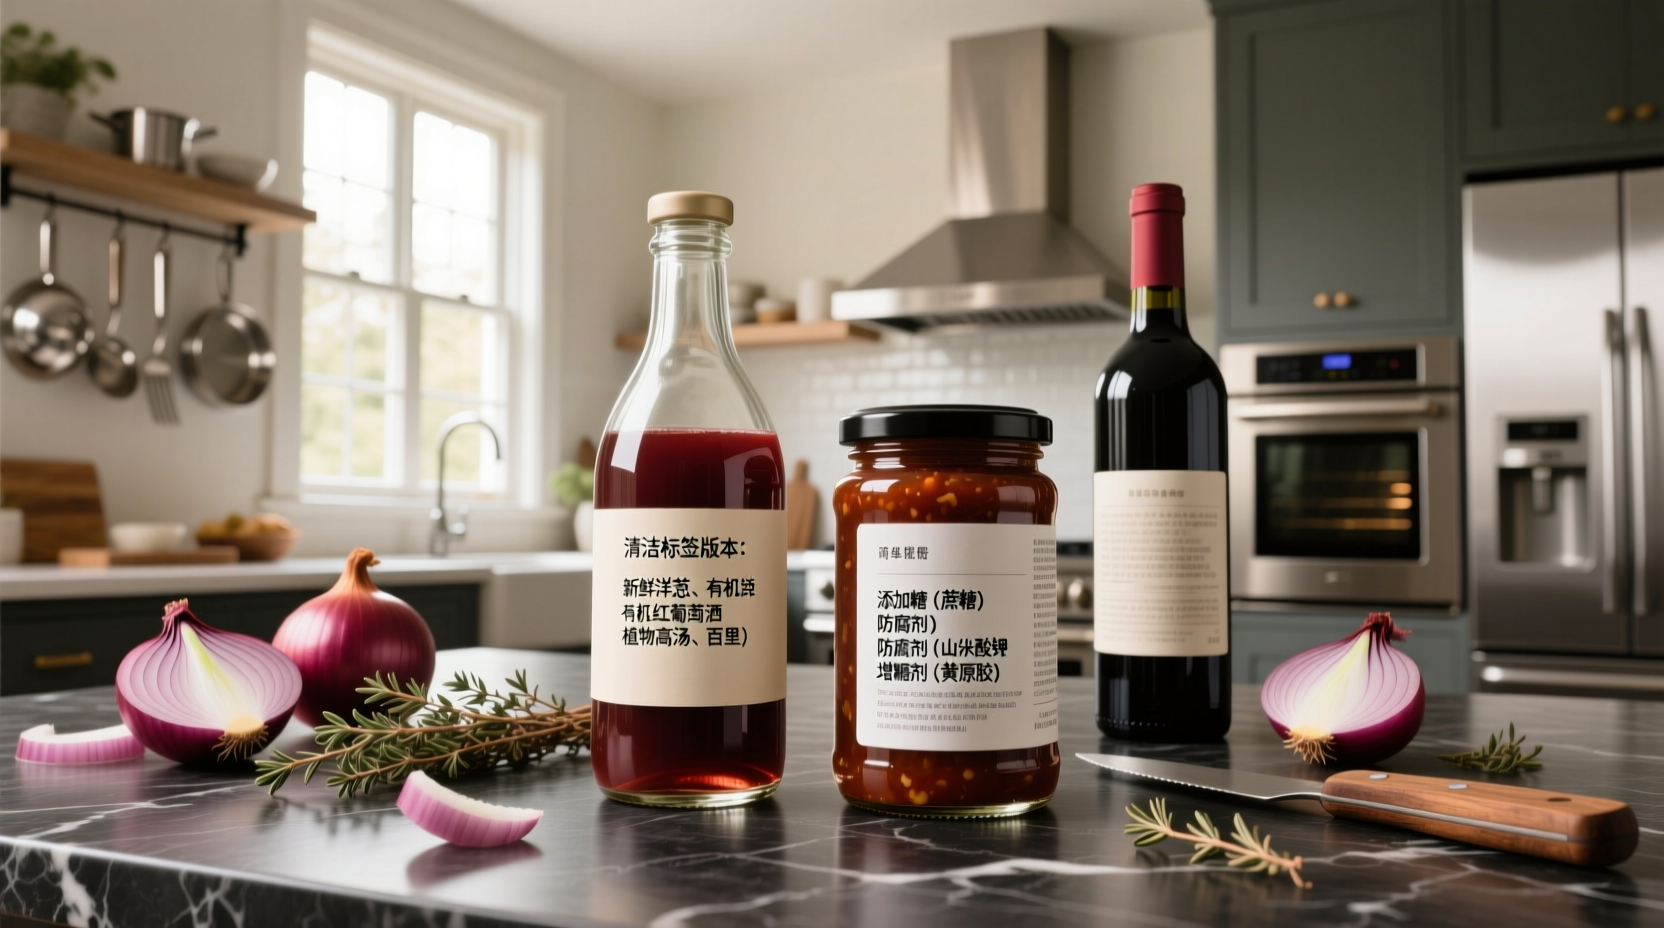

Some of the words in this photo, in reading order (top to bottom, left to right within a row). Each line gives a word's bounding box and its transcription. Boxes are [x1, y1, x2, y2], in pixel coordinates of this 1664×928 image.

[624, 536, 745, 559] 清洁标签版本：
